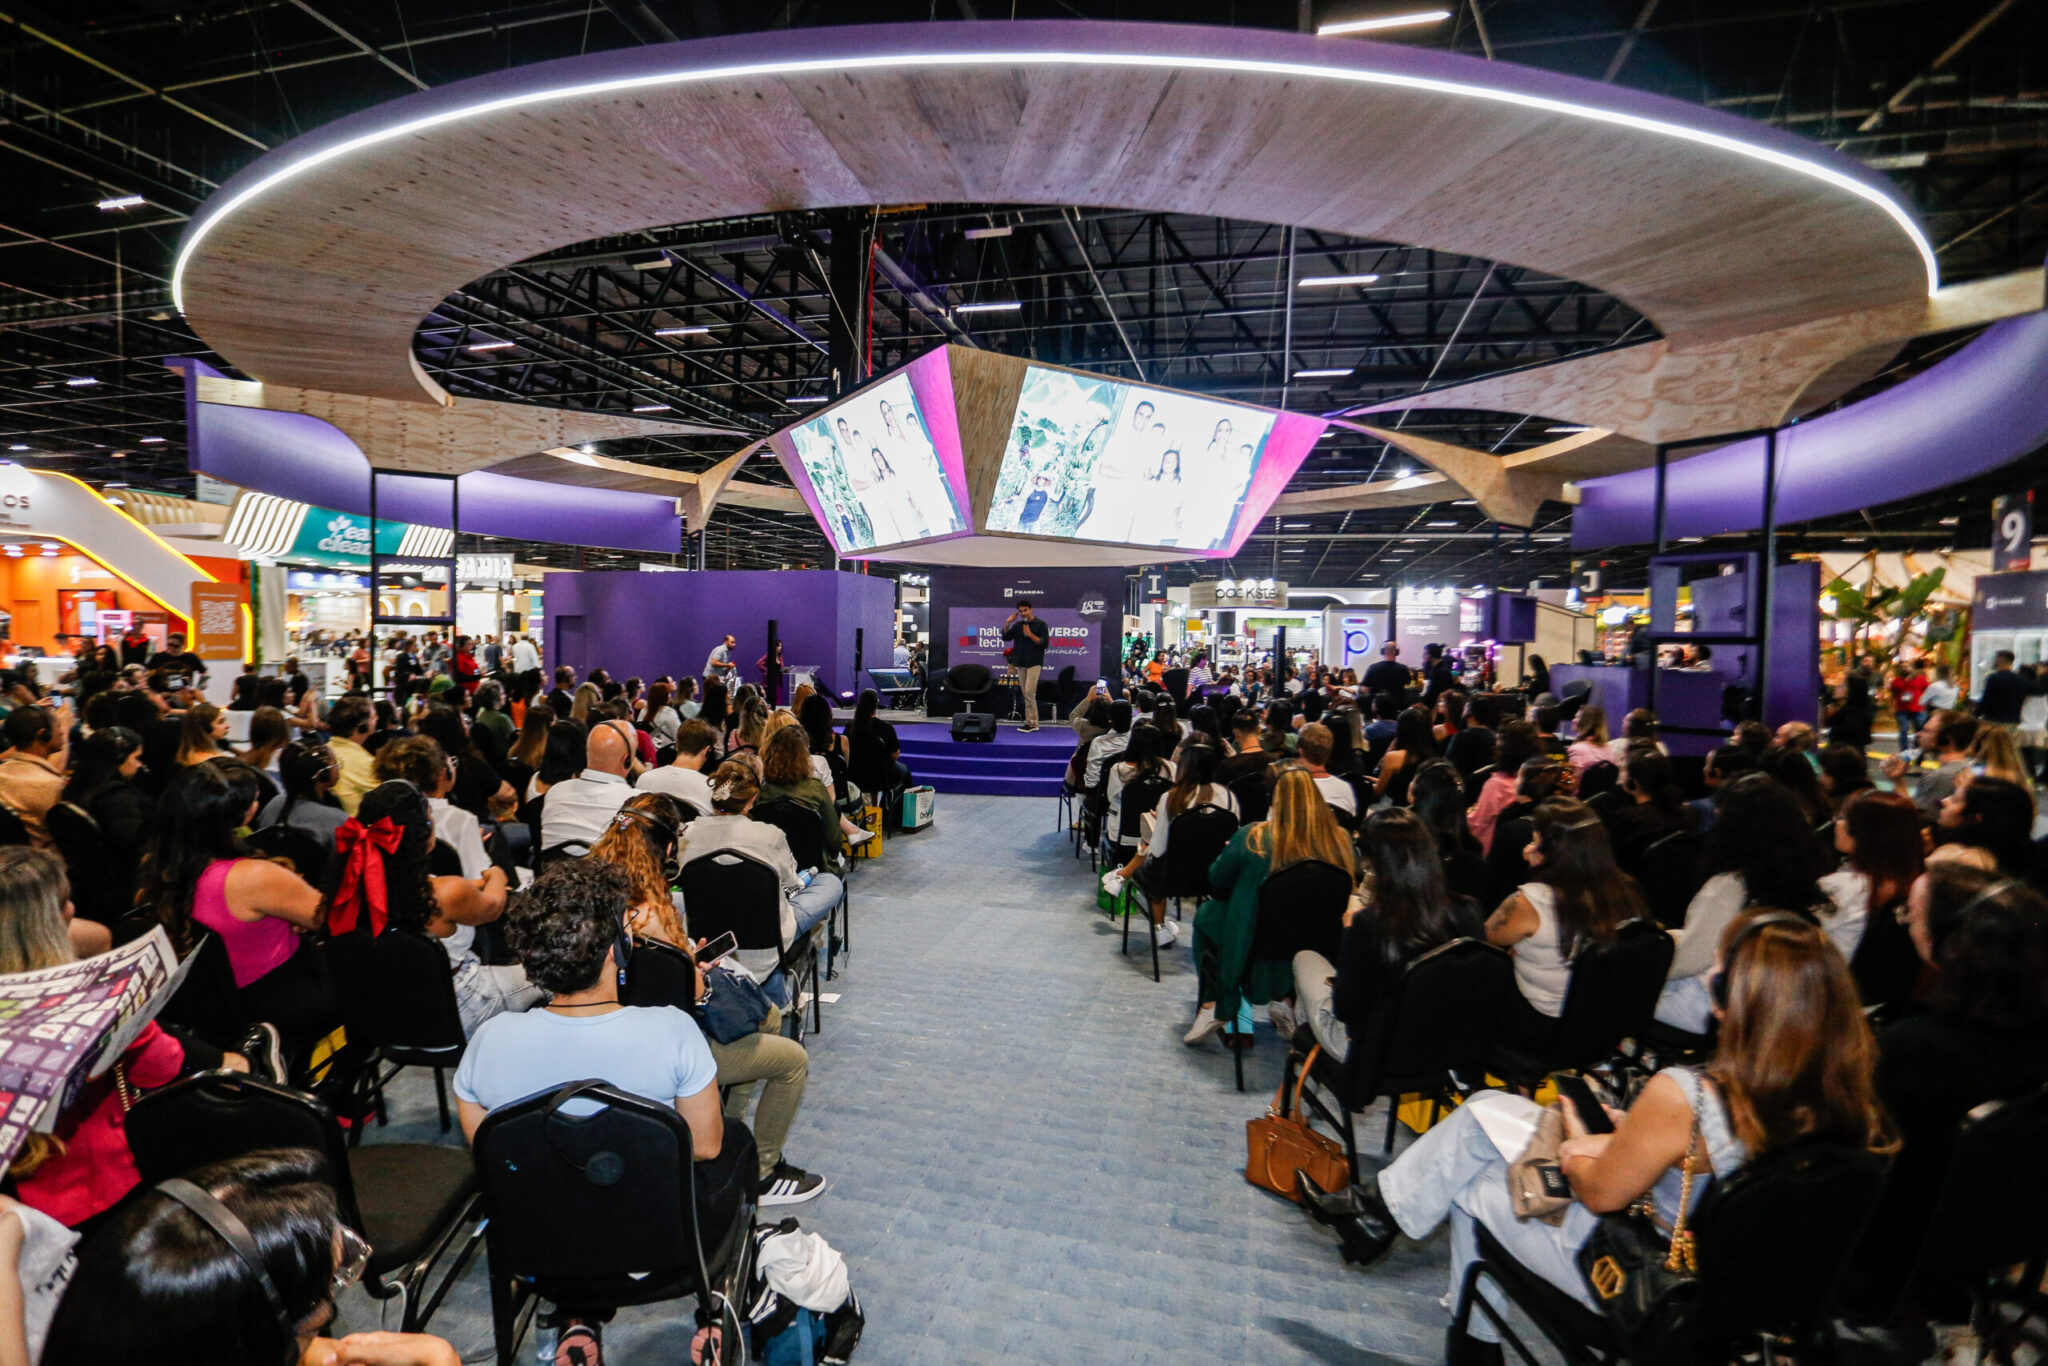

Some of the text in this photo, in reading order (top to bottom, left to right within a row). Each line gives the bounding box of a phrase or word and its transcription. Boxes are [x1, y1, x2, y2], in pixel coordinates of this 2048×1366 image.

[3, 494, 30, 509] OS
[2002, 510, 2026, 552] 9
[1147, 575, 1161, 594] I
[1580, 571, 1599, 592] J
[979, 626, 1003, 637] natu
[1048, 627, 1089, 637] VERSO
[979, 637, 1005, 648] tech
